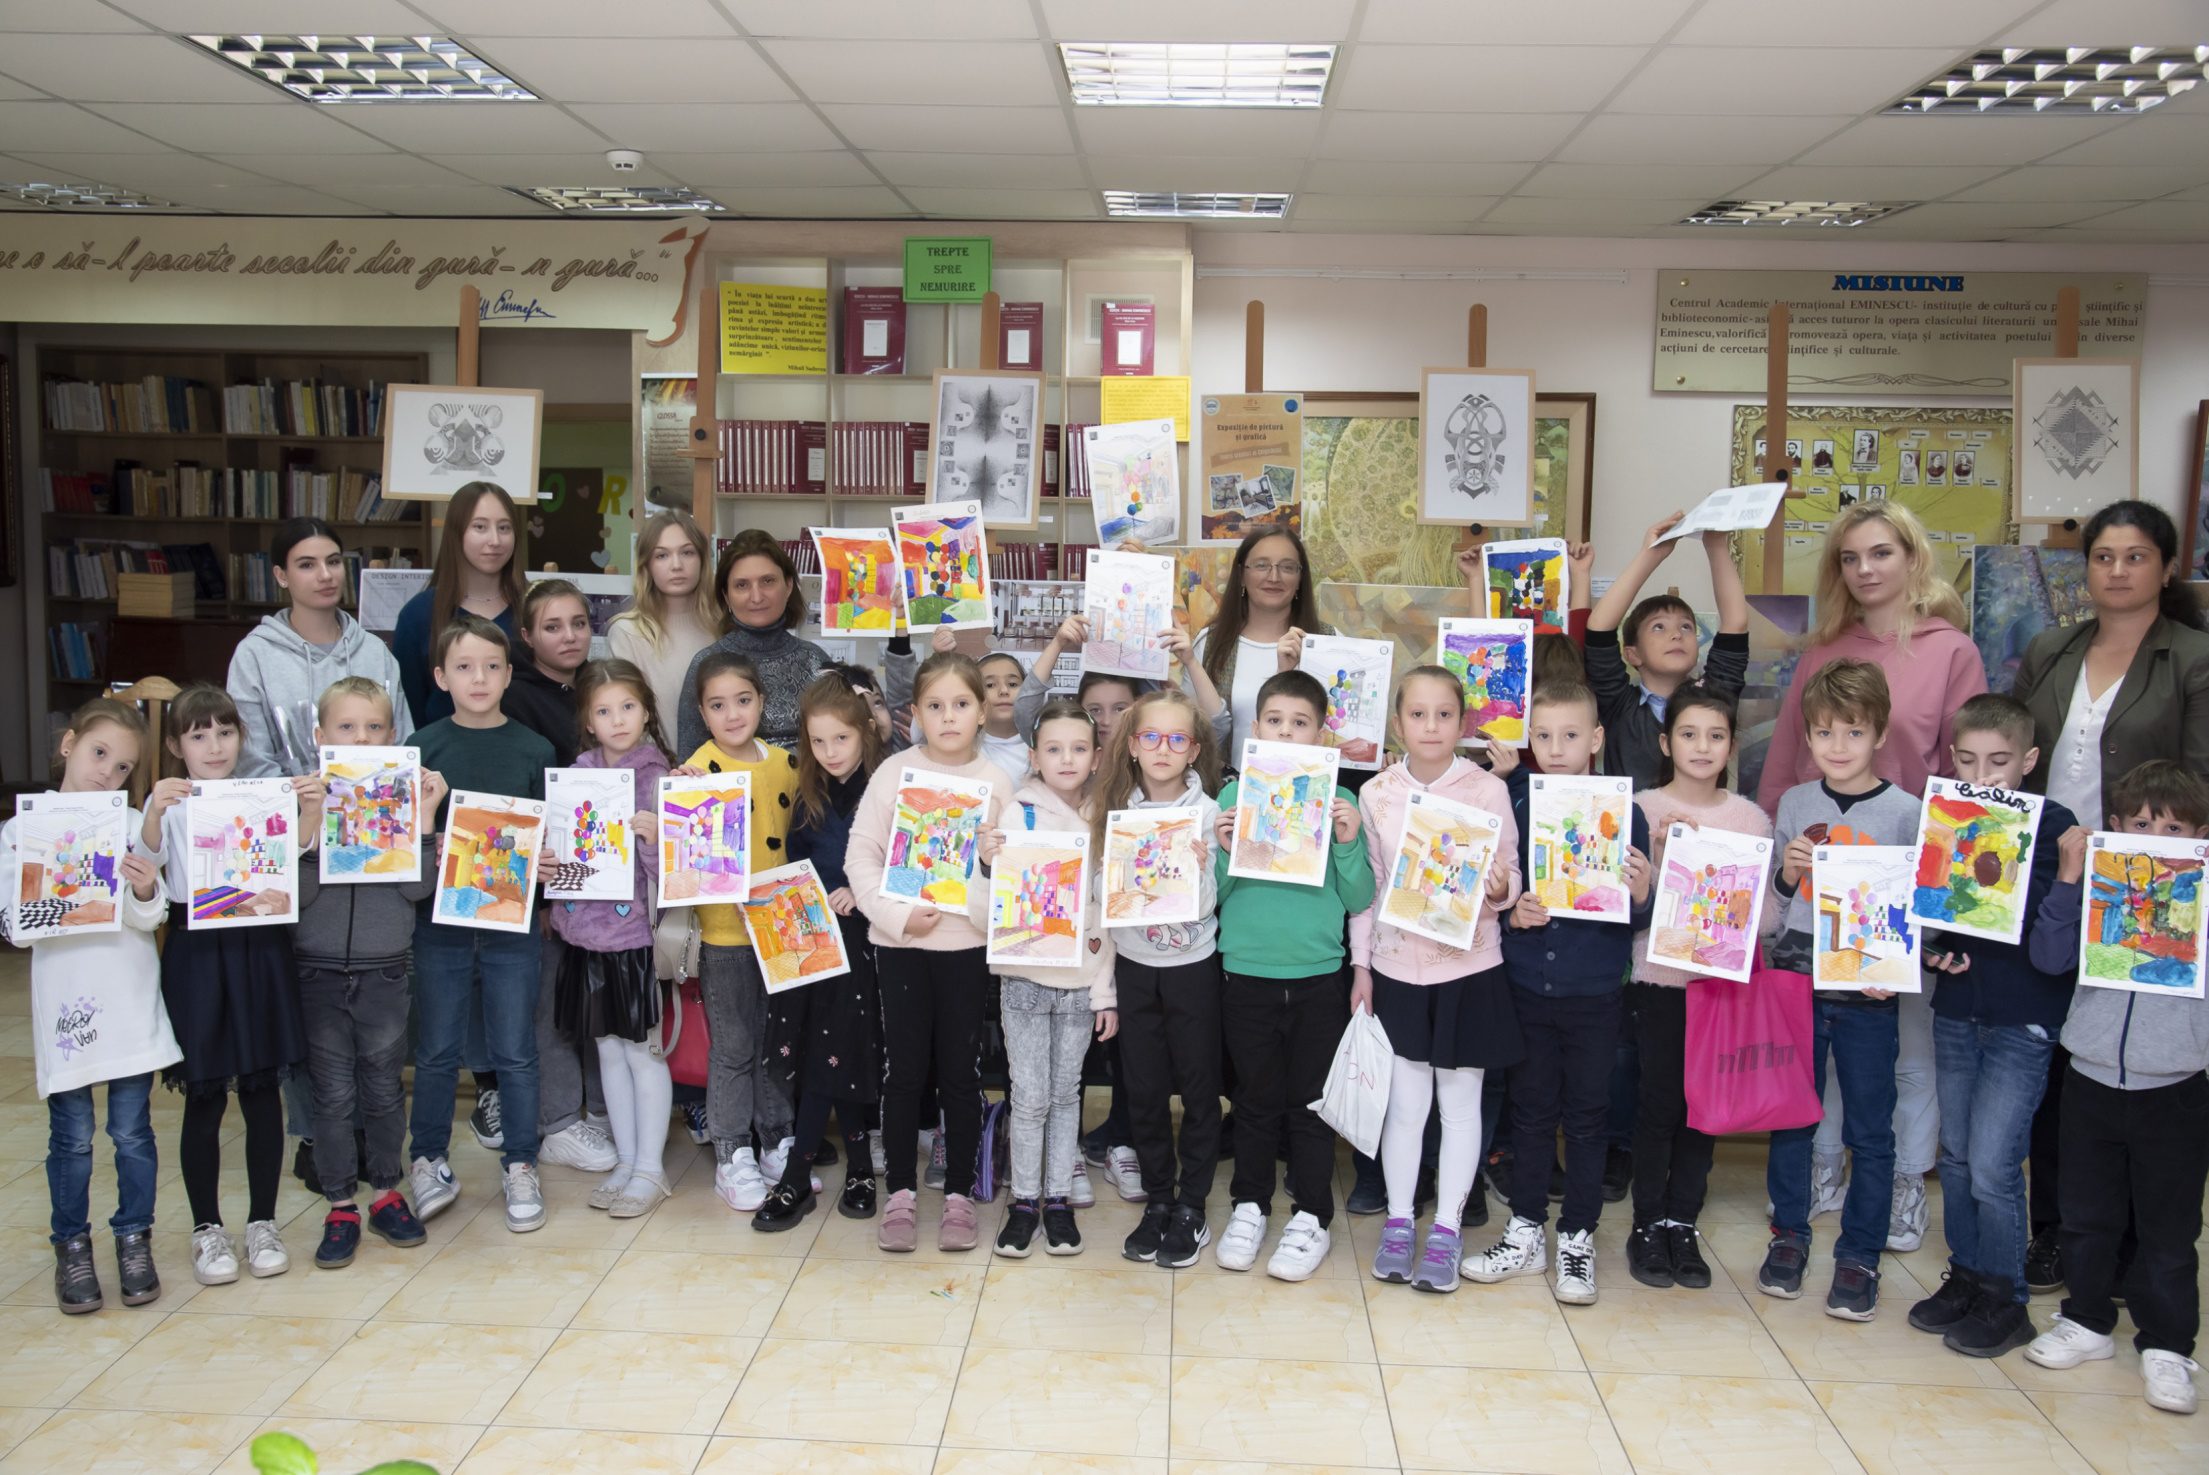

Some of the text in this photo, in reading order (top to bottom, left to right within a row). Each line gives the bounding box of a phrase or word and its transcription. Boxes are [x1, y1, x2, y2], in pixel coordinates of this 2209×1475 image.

[926, 246, 970, 257] TREPTE
[131, 242, 236, 283] poarte
[354, 239, 416, 275] din
[933, 264, 963, 275] SPRE
[919, 281, 977, 293] NEMURIRE
[1831, 274, 1966, 292] MISIUNE
[1669, 297, 1712, 308] Centrul
[1715, 298, 1770, 309] Academic
[1922, 300, 1972, 313] instituție
[1977, 300, 1991, 311] de
[1993, 299, 2031, 312] cultură
[2034, 303, 2048, 312] cu
[2133, 302, 2144, 314] și
[1799, 316, 1828, 325] acces
[1831, 315, 1871, 325] tuturor
[1873, 314, 1884, 325] la
[1888, 317, 1920, 328] opera
[1924, 315, 1978, 326] clasicului
[1982, 315, 2036, 327] literaturii
[2105, 317, 2139, 328] Mihai
[1788, 329, 1848, 341] romovează
[1852, 331, 1887, 342] opera,
[1891, 331, 1918, 343] viața
[1922, 331, 1932, 344] și
[1938, 331, 1997, 342] activitatea
[2005, 331, 2052, 343] poetului
[2094, 331, 2136, 343] diverse
[1660, 342, 1698, 355] acțiuni
[1702, 342, 1716, 353] de
[1719, 344, 1769, 354] cercetare
[1832, 344, 1843, 358] și
